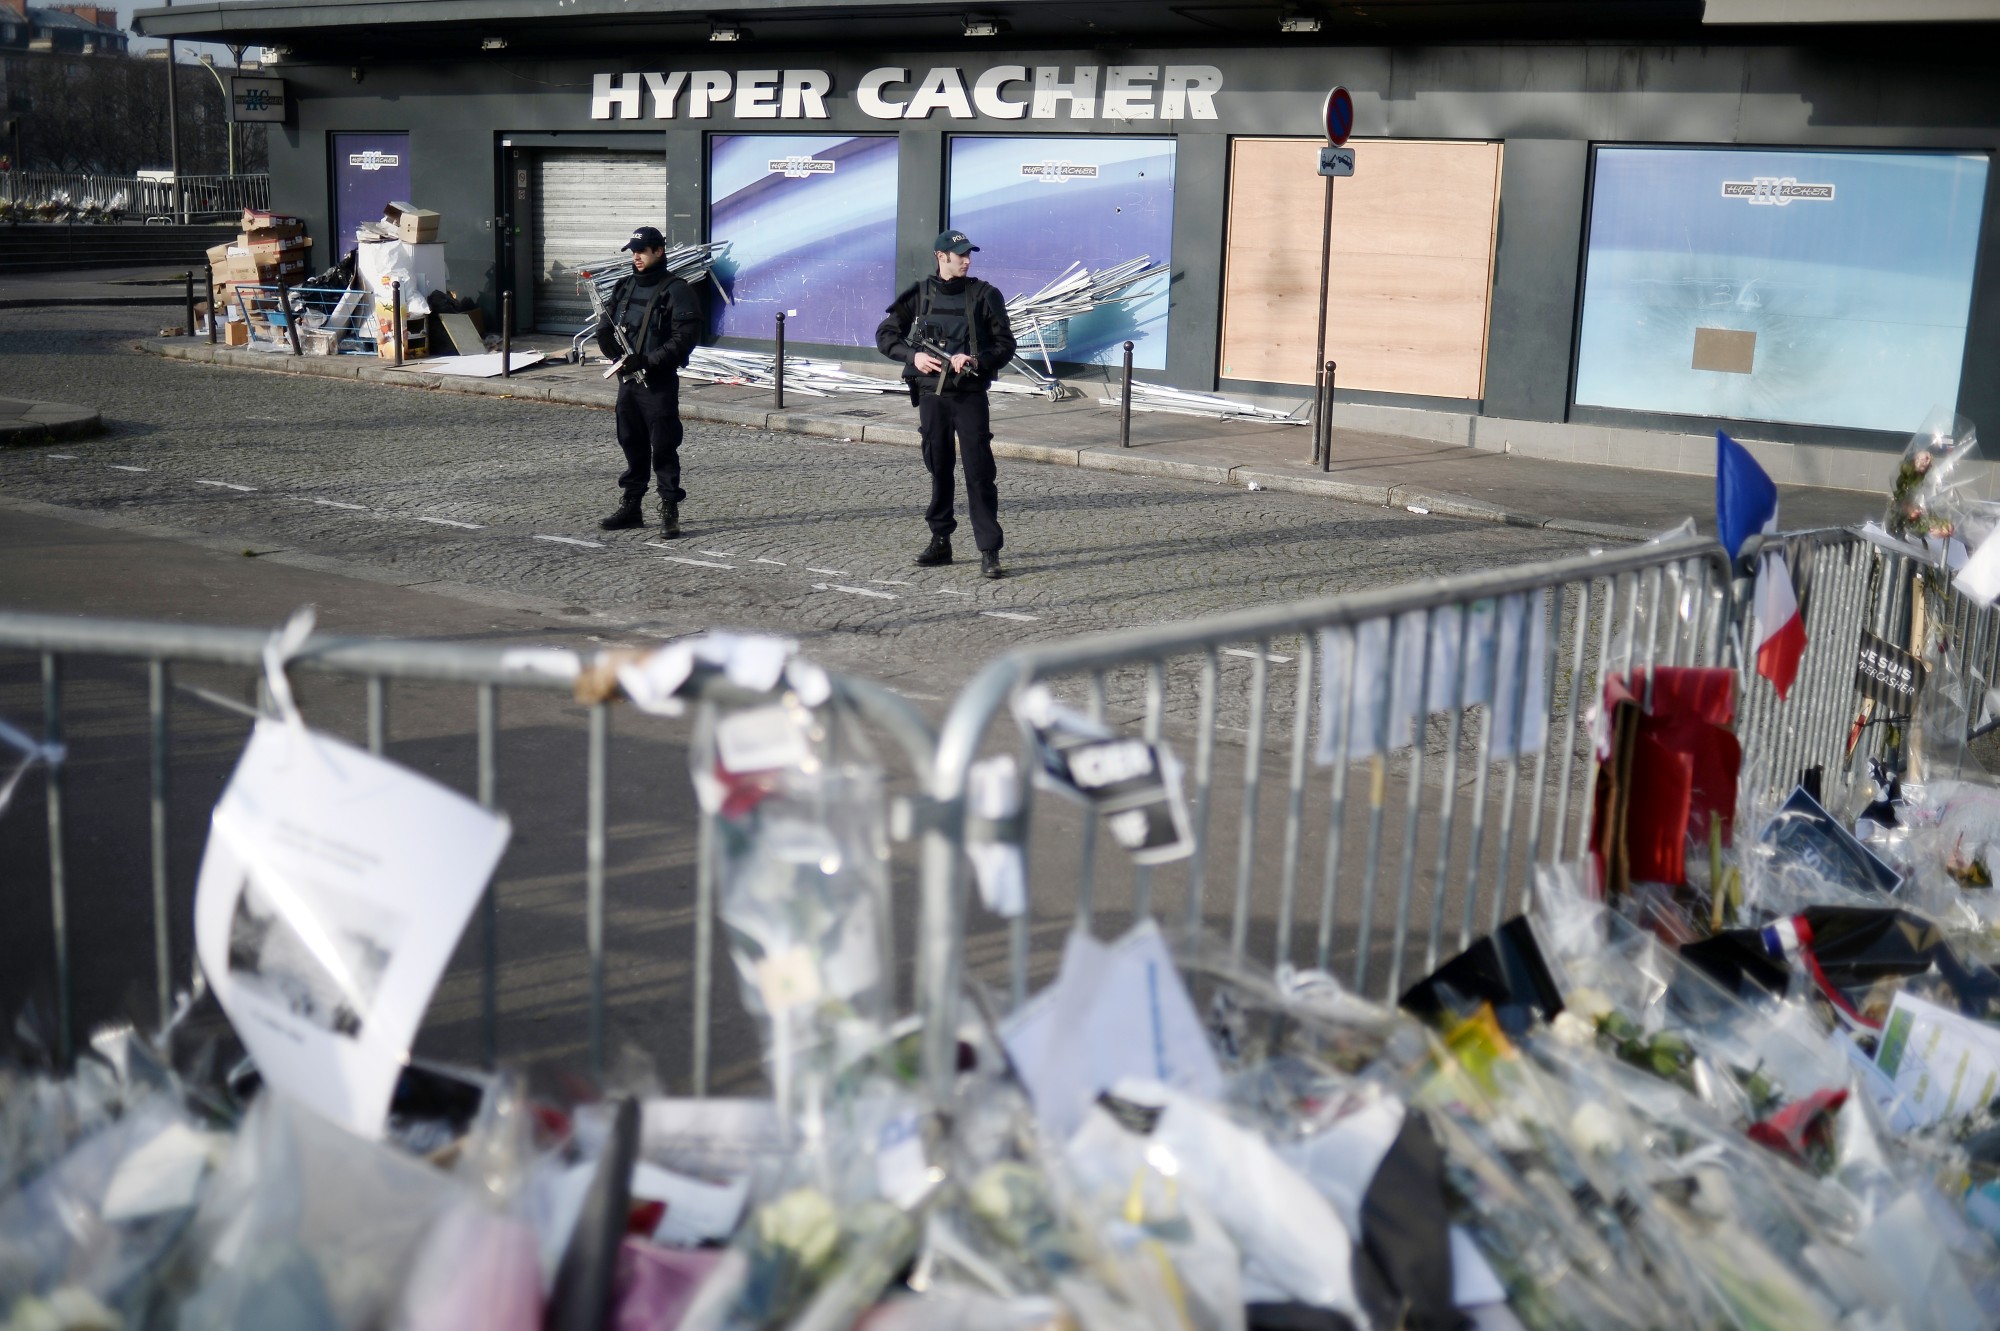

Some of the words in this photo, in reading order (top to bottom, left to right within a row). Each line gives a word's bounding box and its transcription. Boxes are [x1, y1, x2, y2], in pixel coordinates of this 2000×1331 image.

[246, 89, 269, 111] HC
[591, 69, 832, 120] HYPER
[857, 65, 1224, 120] CACHER
[785, 157, 811, 177] HC
[1041, 161, 1070, 181] HC
[1750, 179, 1794, 203] HC
[1860, 649, 1878, 664] JE
[1877, 657, 1912, 681] SUIS
